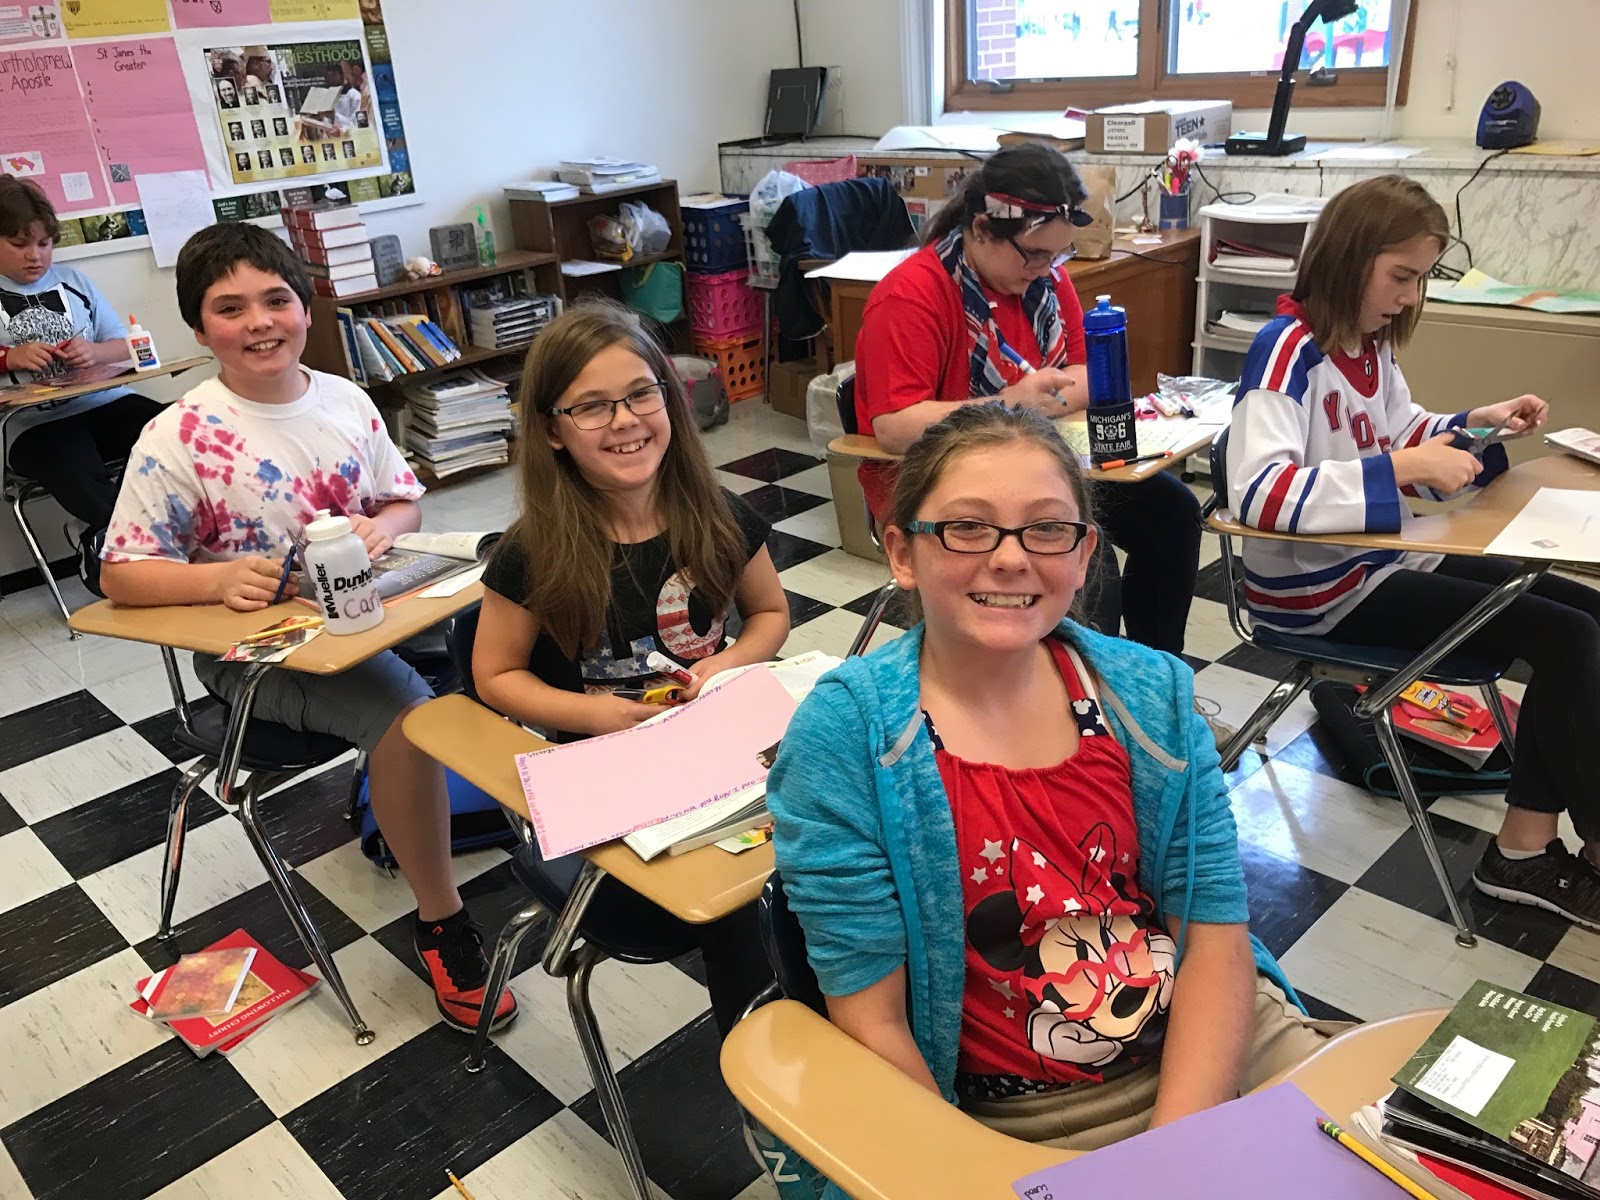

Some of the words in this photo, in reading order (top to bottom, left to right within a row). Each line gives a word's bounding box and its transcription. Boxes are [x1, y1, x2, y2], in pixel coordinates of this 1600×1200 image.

[114, 47, 135, 58] James
[139, 44, 152, 55] the
[275, 48, 360, 66] PRIESTHOOD
[114, 59, 147, 72] Greater
[11, 72, 53, 96] Apostle
[1174, 117, 1199, 137] TEEN
[1089, 411, 1132, 424] MICHIGAN'S
[1094, 442, 1114, 451] STATE
[1115, 440, 1132, 450] FAIR
[315, 563, 338, 615] Mueller
[526, 748, 556, 758] Strange
[700, 798, 712, 808] not
[241, 989, 291, 1021] FOLLOWING
[208, 1018, 241, 1039] CHRIST
